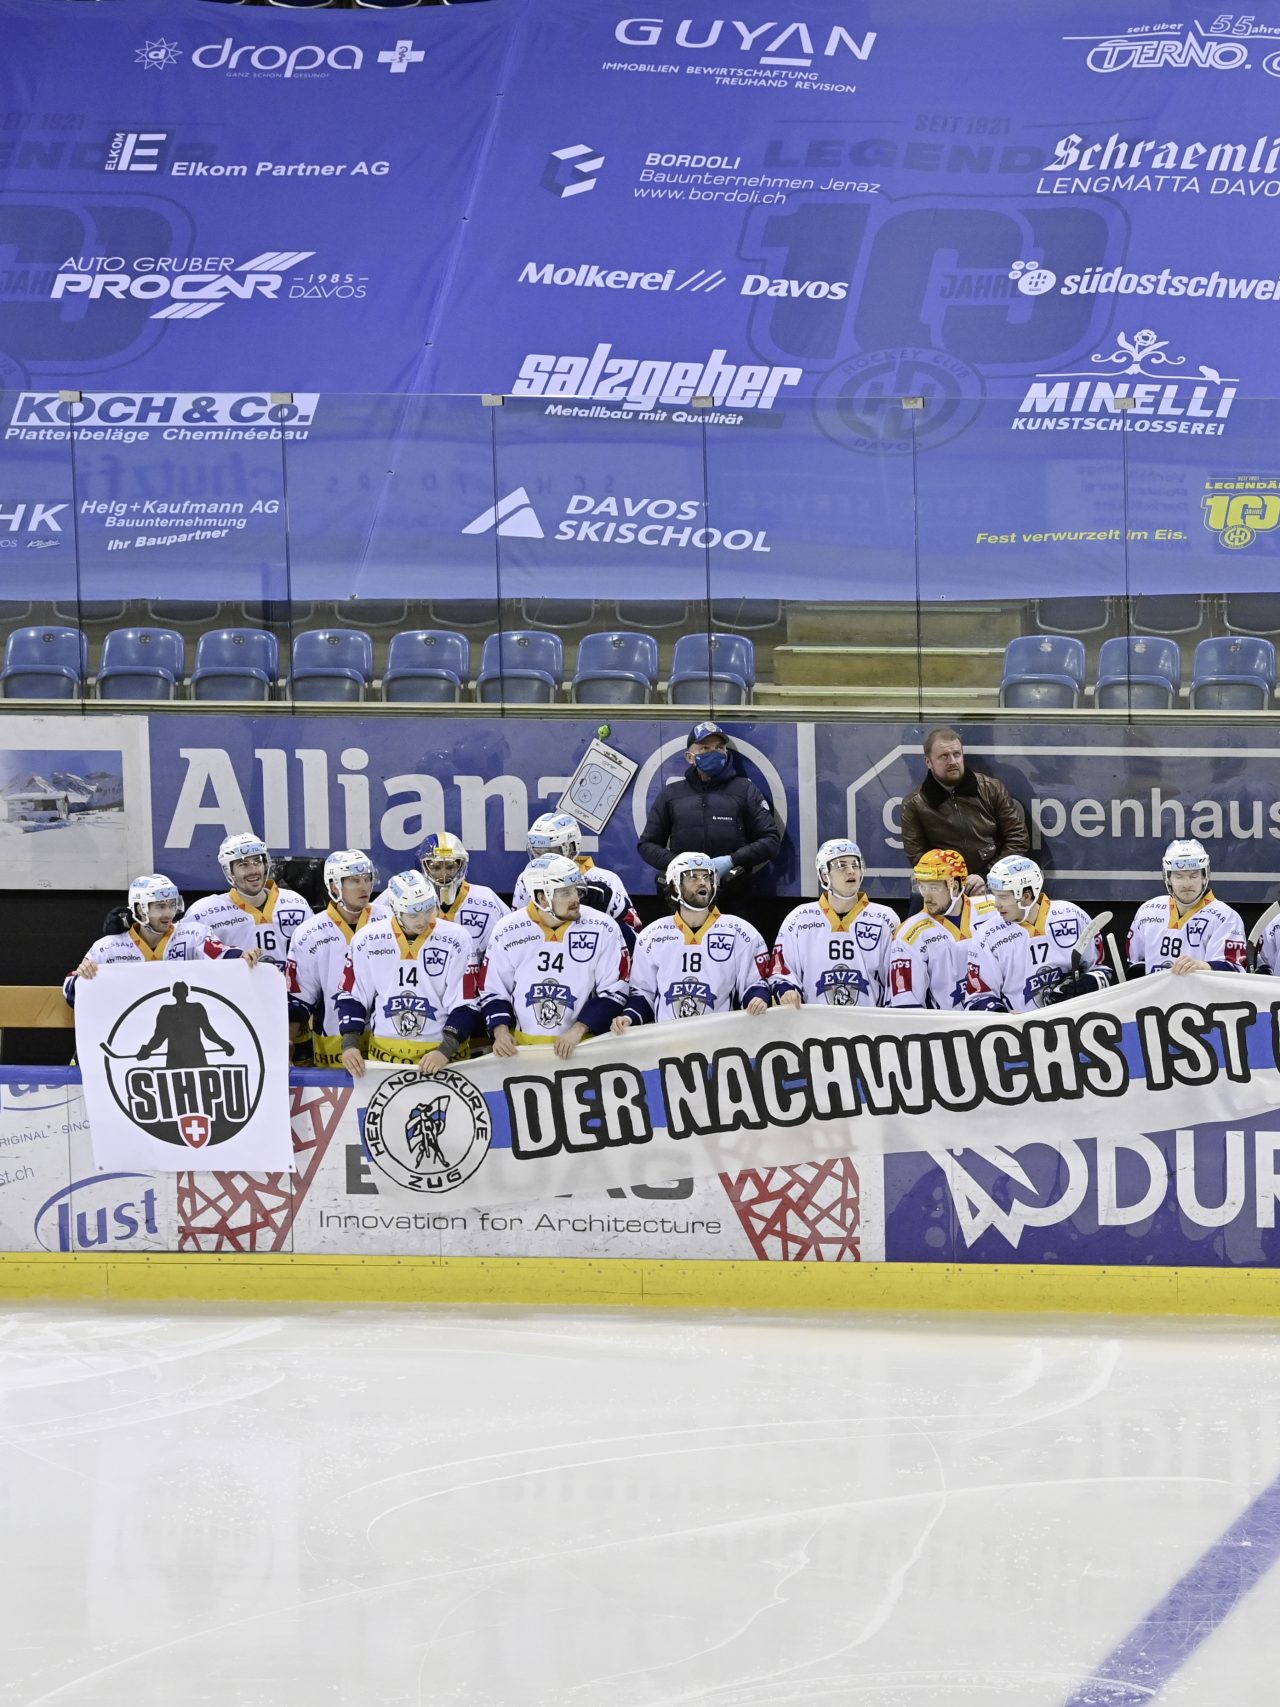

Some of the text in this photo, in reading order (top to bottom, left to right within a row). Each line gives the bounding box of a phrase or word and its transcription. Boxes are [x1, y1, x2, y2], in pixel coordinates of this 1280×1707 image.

[1127, 25, 1150, 34] seit
[1153, 22, 1184, 31] über
[614, 18, 878, 62] GUYAN
[191, 37, 363, 78] dropa
[602, 61, 819, 82] IMMOBILIEN BEWIRTSCHAFTUNG
[714, 76, 857, 93] TREUHAND REVISION
[104, 132, 126, 171] ELKOM
[645, 152, 741, 170] BORDOLI
[171, 161, 390, 177] Elkom Partner AG
[640, 168, 881, 194] Bauunternehmen Jenaz
[1036, 174, 1200, 195] LENGMATTA
[633, 186, 787, 205] www.bordoli.ch
[58, 256, 235, 273] AUTO GRUBER
[50, 273, 283, 299] PROCAR
[308, 273, 354, 283] 1985
[517, 262, 849, 300] Molkerei Davos
[289, 285, 367, 299] DAVOS
[15, 395, 313, 424] KOCH & Co.
[1018, 381, 1237, 419] MINELLI
[545, 404, 744, 426] Metallbau mit Qualität
[4, 427, 310, 444] Plattenbeläge Cheminéebau
[1011, 416, 1226, 437] KUNSTSCHLOSSEREI
[81, 499, 280, 516] Helg+Kaufmann AG
[564, 494, 701, 521] DAVOS
[105, 515, 247, 530] Bauunternehmung
[107, 528, 229, 551] Ihr Baupartner
[554, 519, 771, 552] SKISCHOOL
[975, 528, 1189, 545] Fest verwurzelt im Eis.
[255, 931, 276, 950] 16
[1054, 927, 1077, 937] ZUG
[571, 940, 595, 949] ZUG
[709, 942, 732, 950] ZUG
[829, 940, 855, 960] 66
[1029, 942, 1050, 965] 17
[1159, 936, 1183, 958] 88
[537, 951, 564, 973] 34
[681, 952, 702, 973] 18
[398, 966, 419, 987] 14
[824, 972, 859, 984] EVZ
[1029, 969, 1062, 992] EVZ
[532, 984, 568, 1000] EVZ
[671, 984, 708, 997] EVZ
[391, 996, 427, 1011] EVZ
[504, 1062, 654, 1160] DER
[659, 1011, 1129, 1140] NACHWUCHS
[1135, 1000, 1258, 1091] IST
[126, 1068, 249, 1121] SIHPU
[388, 1068, 489, 1142] NORDKURVE
[366, 1092, 389, 1157] HERTI
[408, 1169, 462, 1189] ZUG
[318, 1210, 723, 1236] Innovation for Architecture
